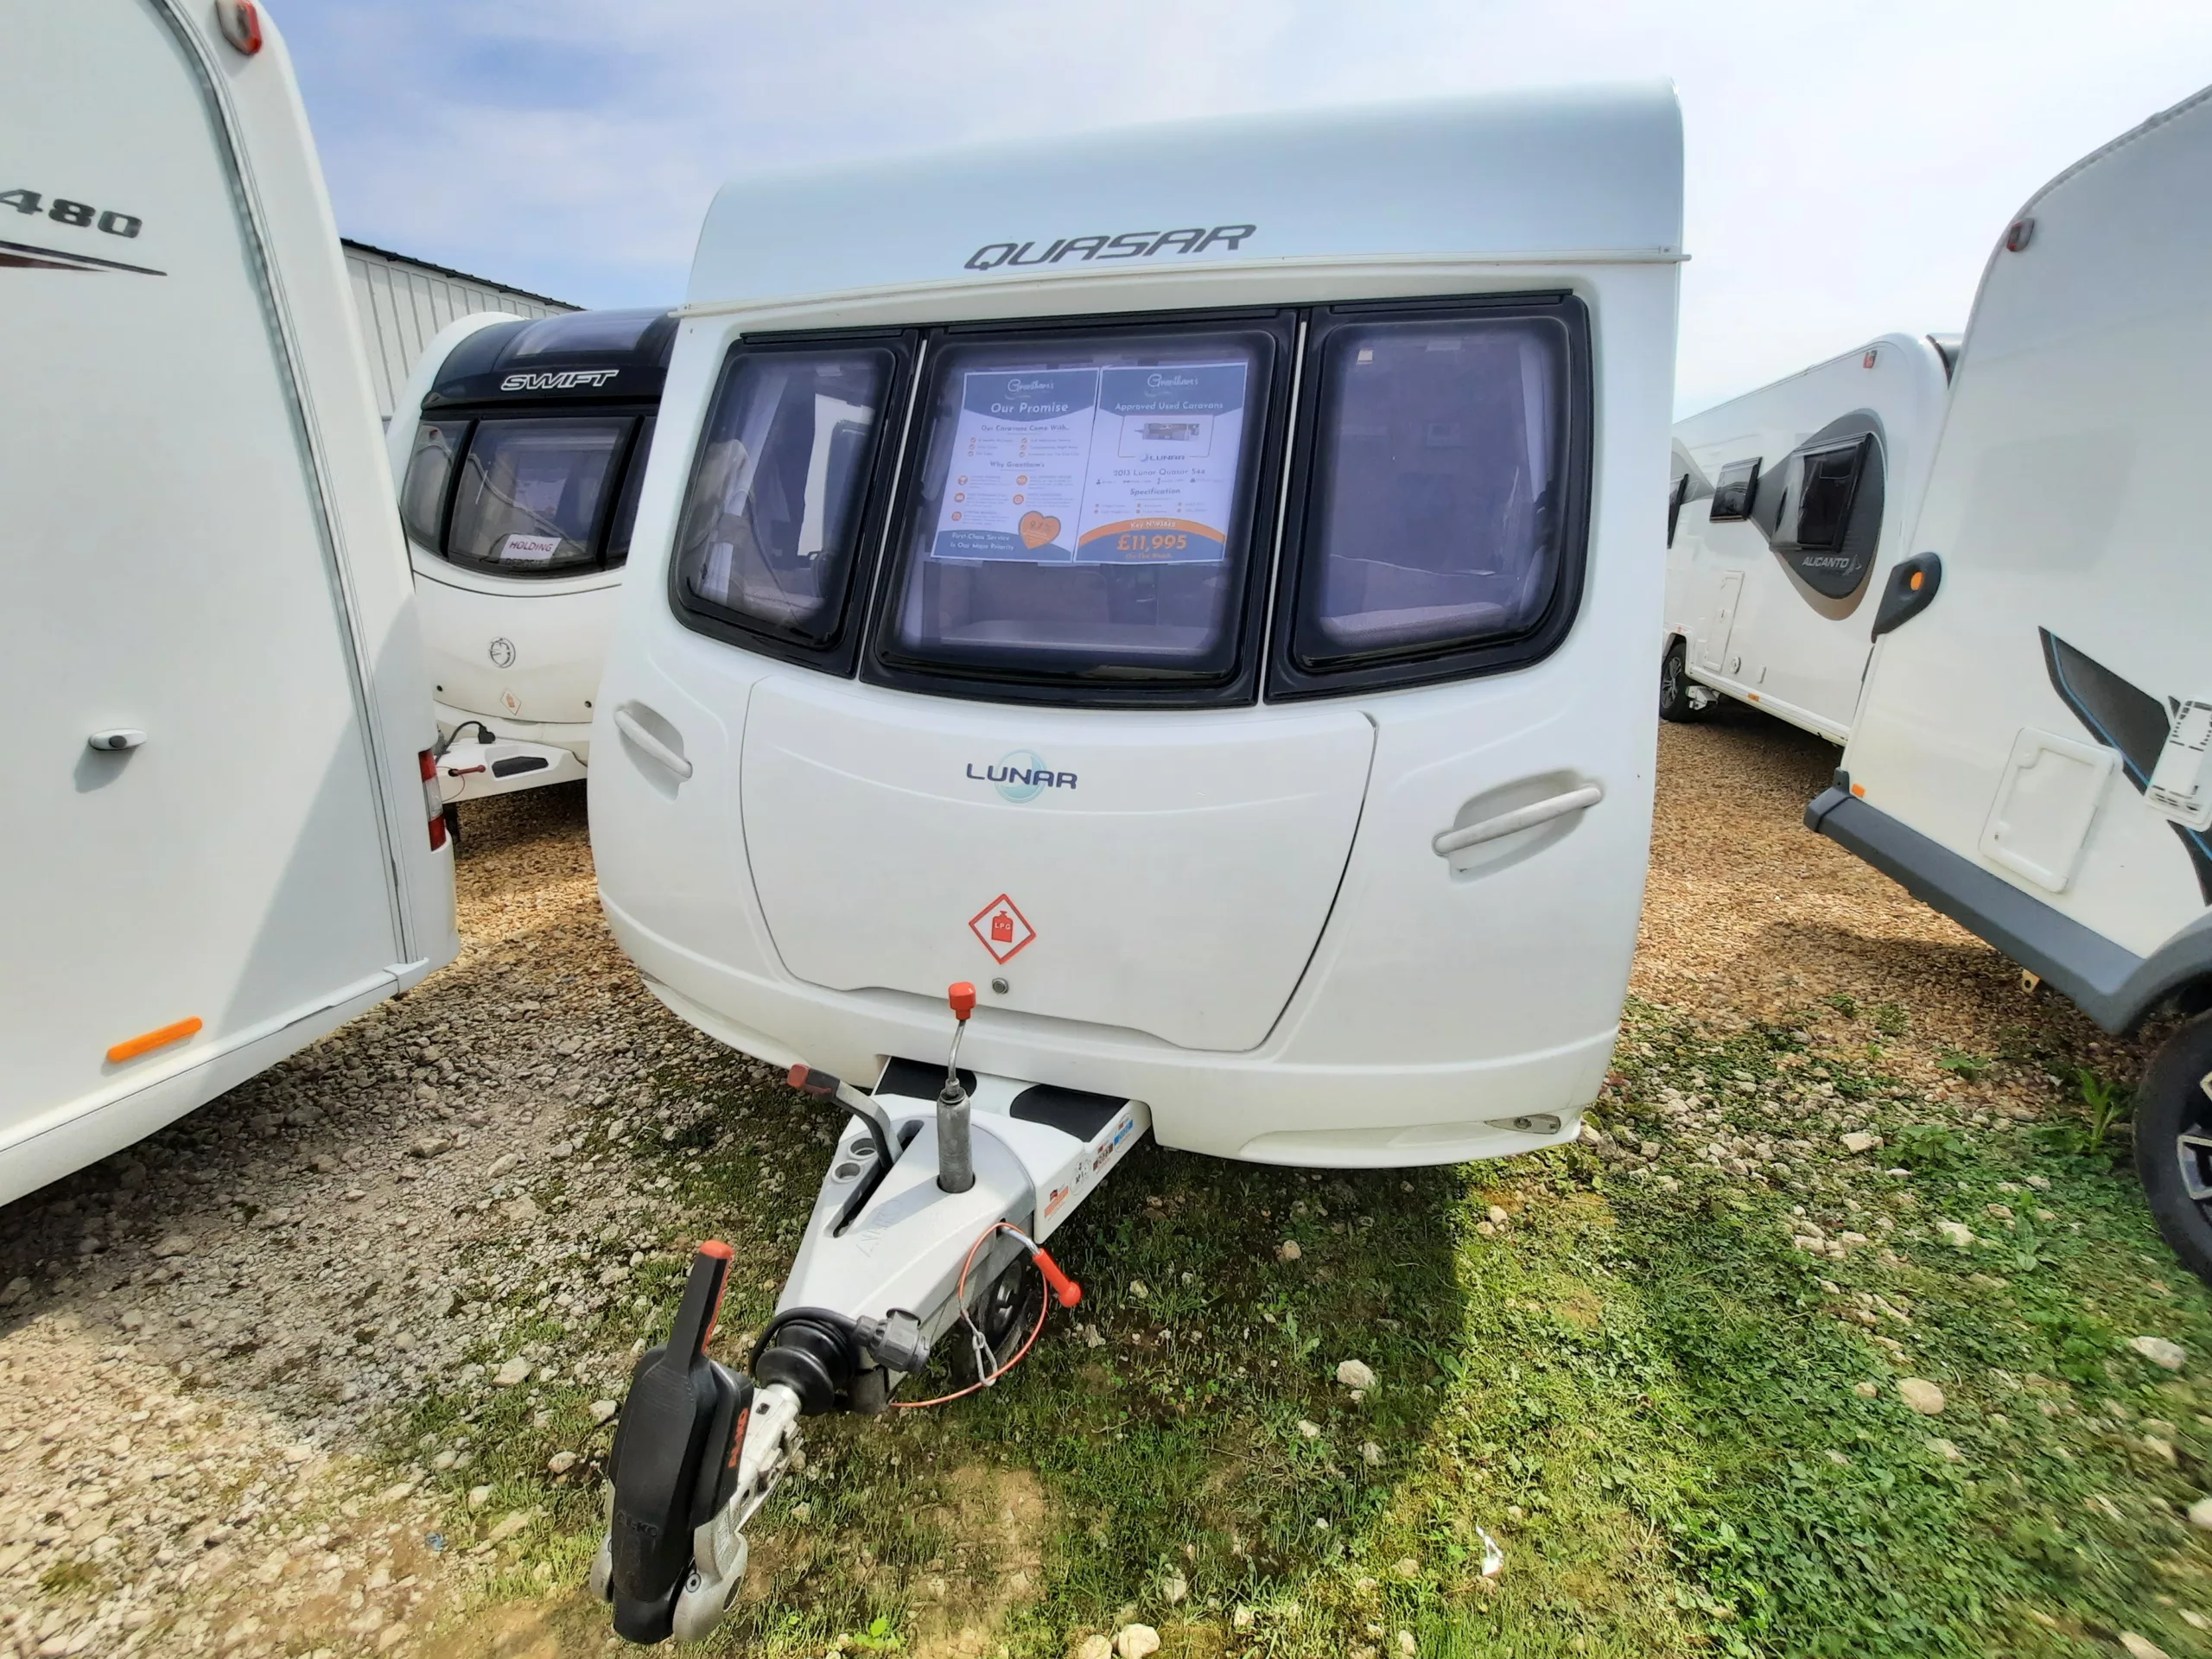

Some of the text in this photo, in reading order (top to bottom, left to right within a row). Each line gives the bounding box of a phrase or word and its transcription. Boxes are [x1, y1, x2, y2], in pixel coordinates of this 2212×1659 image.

[0, 188, 143, 238] 480
[963, 224, 1257, 271] QUASAR
[500, 369, 620, 391] SWIFT
[990, 402, 1069, 414] Our Promise
[1115, 401, 1224, 412] Approved Used Caravans
[989, 461, 1004, 469] Why
[1159, 467, 1189, 476] Quasar
[1129, 487, 1181, 497] Specification
[509, 541, 554, 552] HOLDING
[1116, 534, 1188, 552] £11,995
[1801, 556, 1850, 569] ALICANTO
[965, 762, 1078, 790] LUNAR
[994, 921, 1012, 931] LPG
